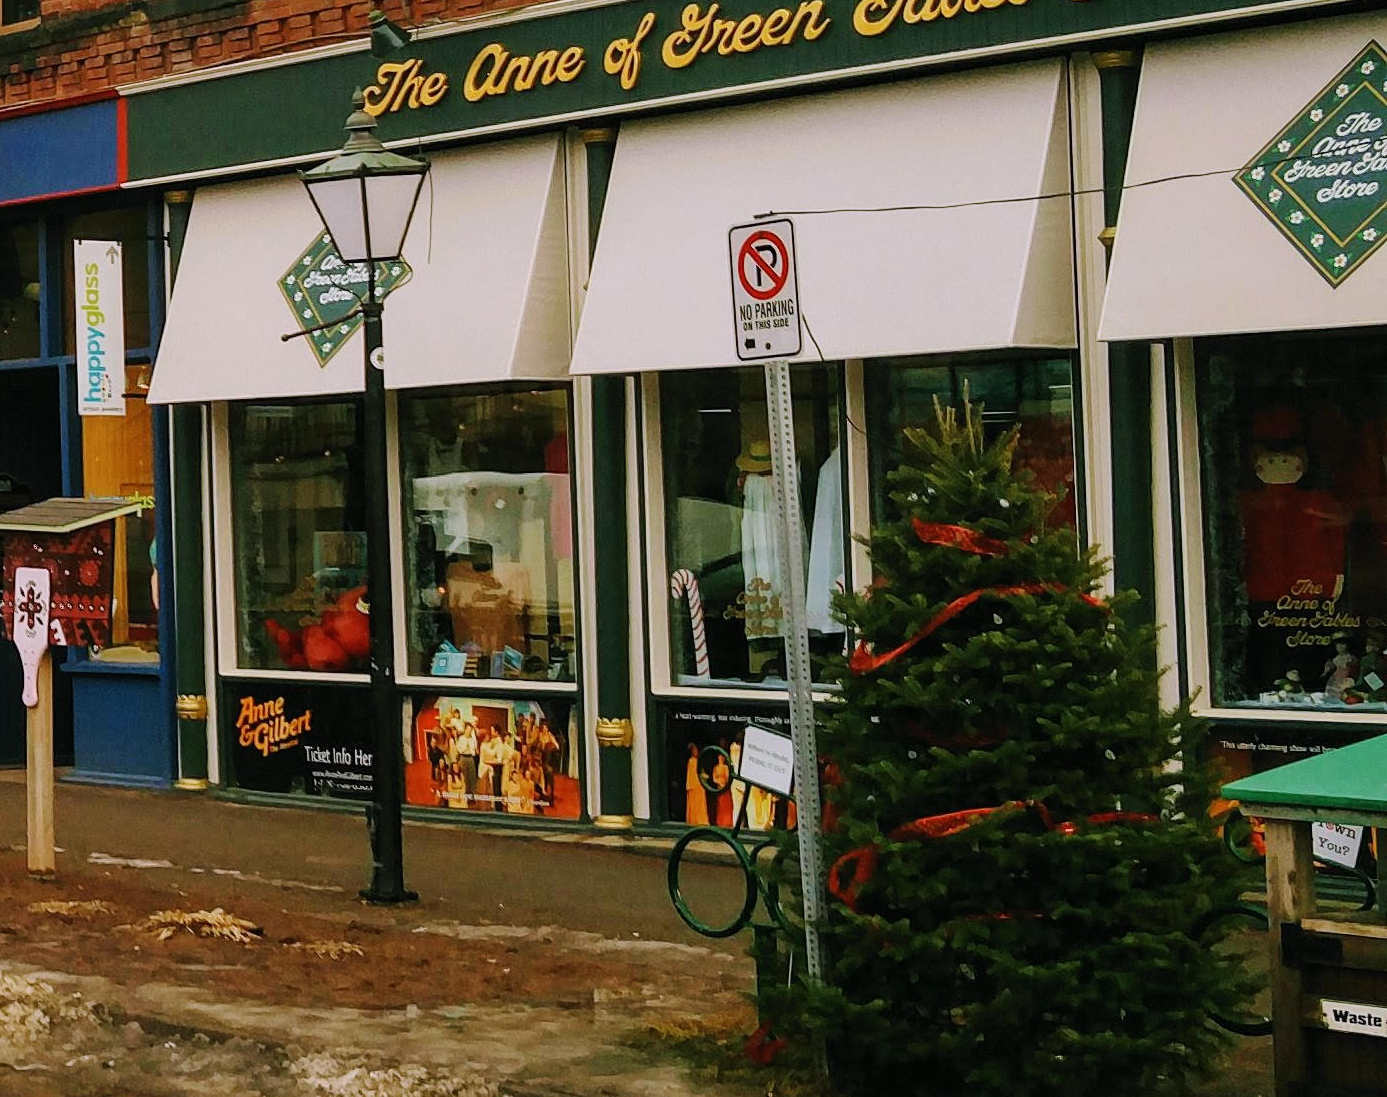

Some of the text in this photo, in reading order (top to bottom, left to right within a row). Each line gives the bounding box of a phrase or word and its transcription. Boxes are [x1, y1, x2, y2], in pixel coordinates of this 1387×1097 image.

[363, 58, 448, 117] The
[463, 44, 585, 103] Anne
[603, 10, 658, 90] of
[662, 0, 829, 70] Green
[1336, 112, 1383, 137] The
[1311, 136, 1371, 158] Anne
[1283, 159, 1353, 183] Green
[1316, 178, 1379, 203] Store
[739, 298, 795, 322] NO PARKING
[743, 317, 790, 332] ON THIS SIDE
[1290, 579, 1323, 595] The
[235, 696, 286, 729] Anne
[304, 745, 332, 764] Ticket
[333, 746, 352, 766] Info
[354, 748, 374, 767] Her
[1318, 836, 1350, 856] You?
[1332, 1008, 1382, 1028] Waste
